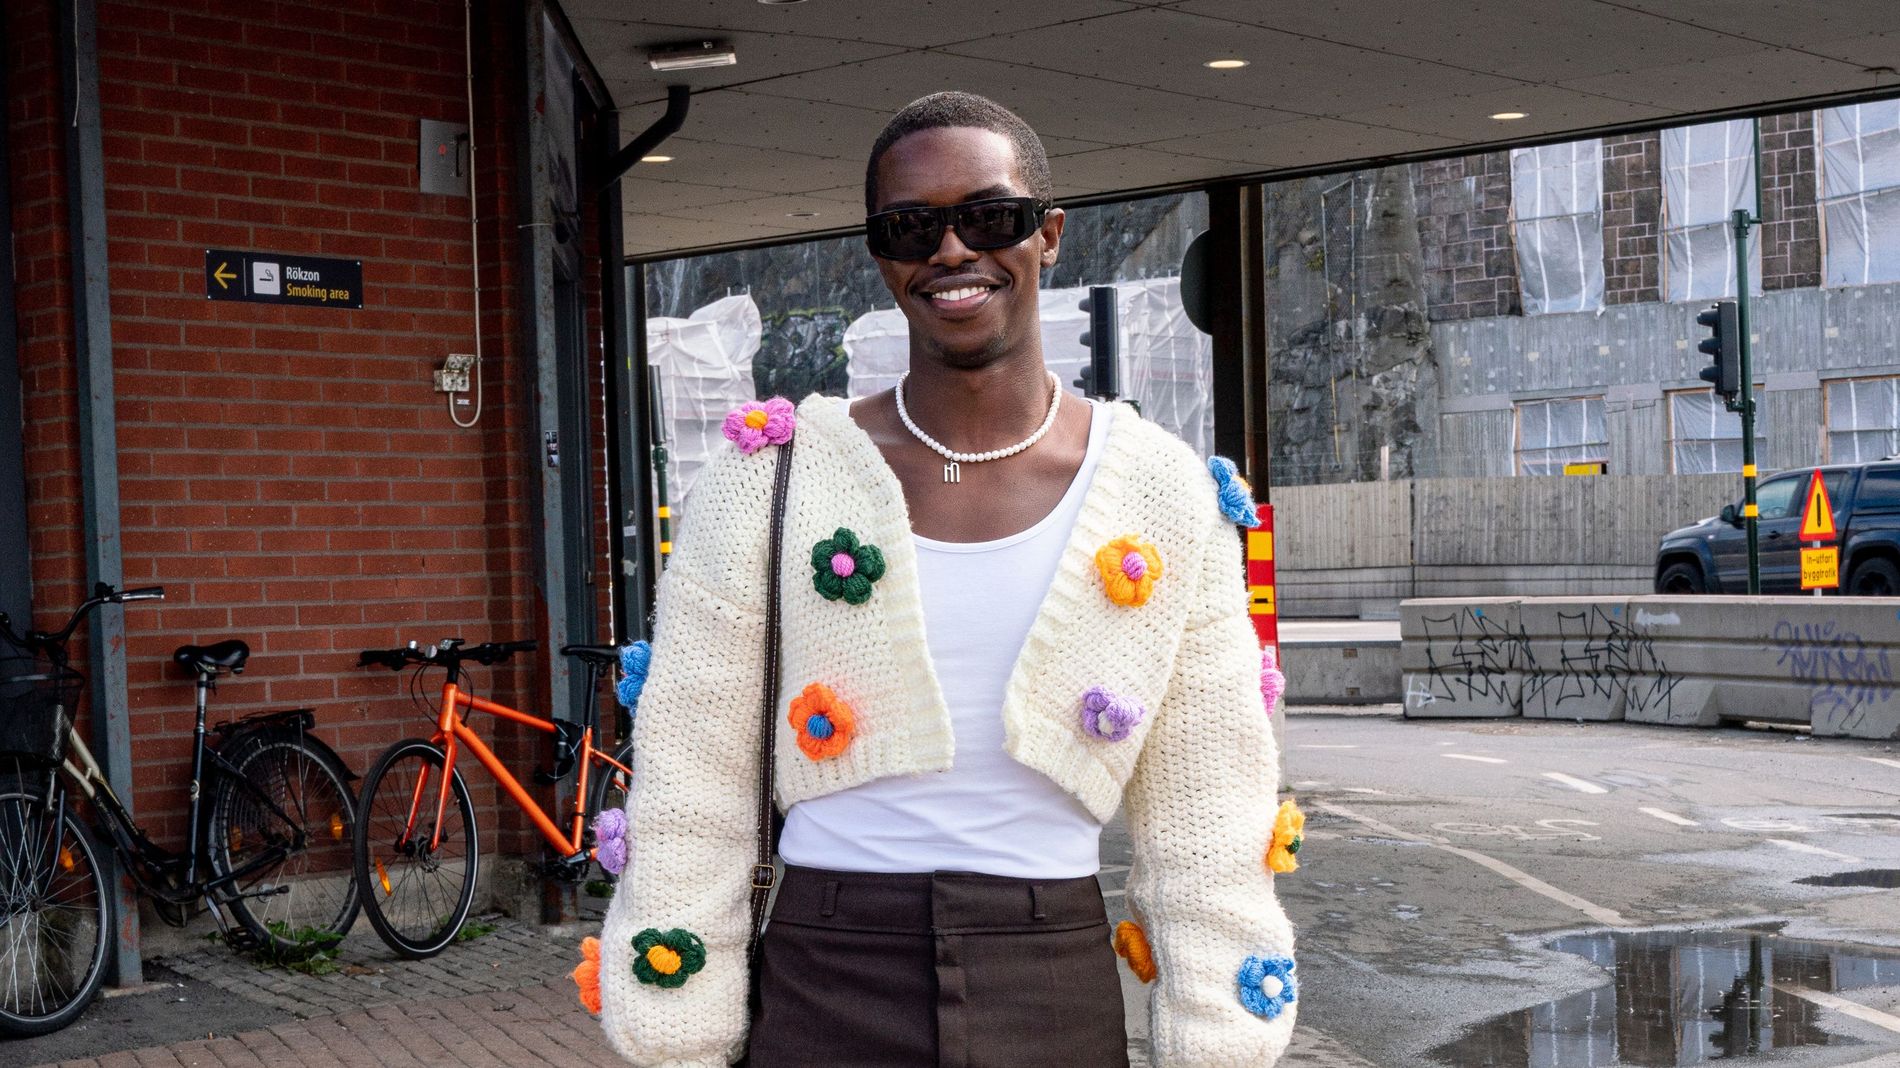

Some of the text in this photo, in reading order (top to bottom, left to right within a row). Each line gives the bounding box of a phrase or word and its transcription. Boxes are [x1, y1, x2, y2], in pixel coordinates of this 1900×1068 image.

[286, 266, 320, 282] Rökzon
[286, 283, 350, 302] Smoking area
